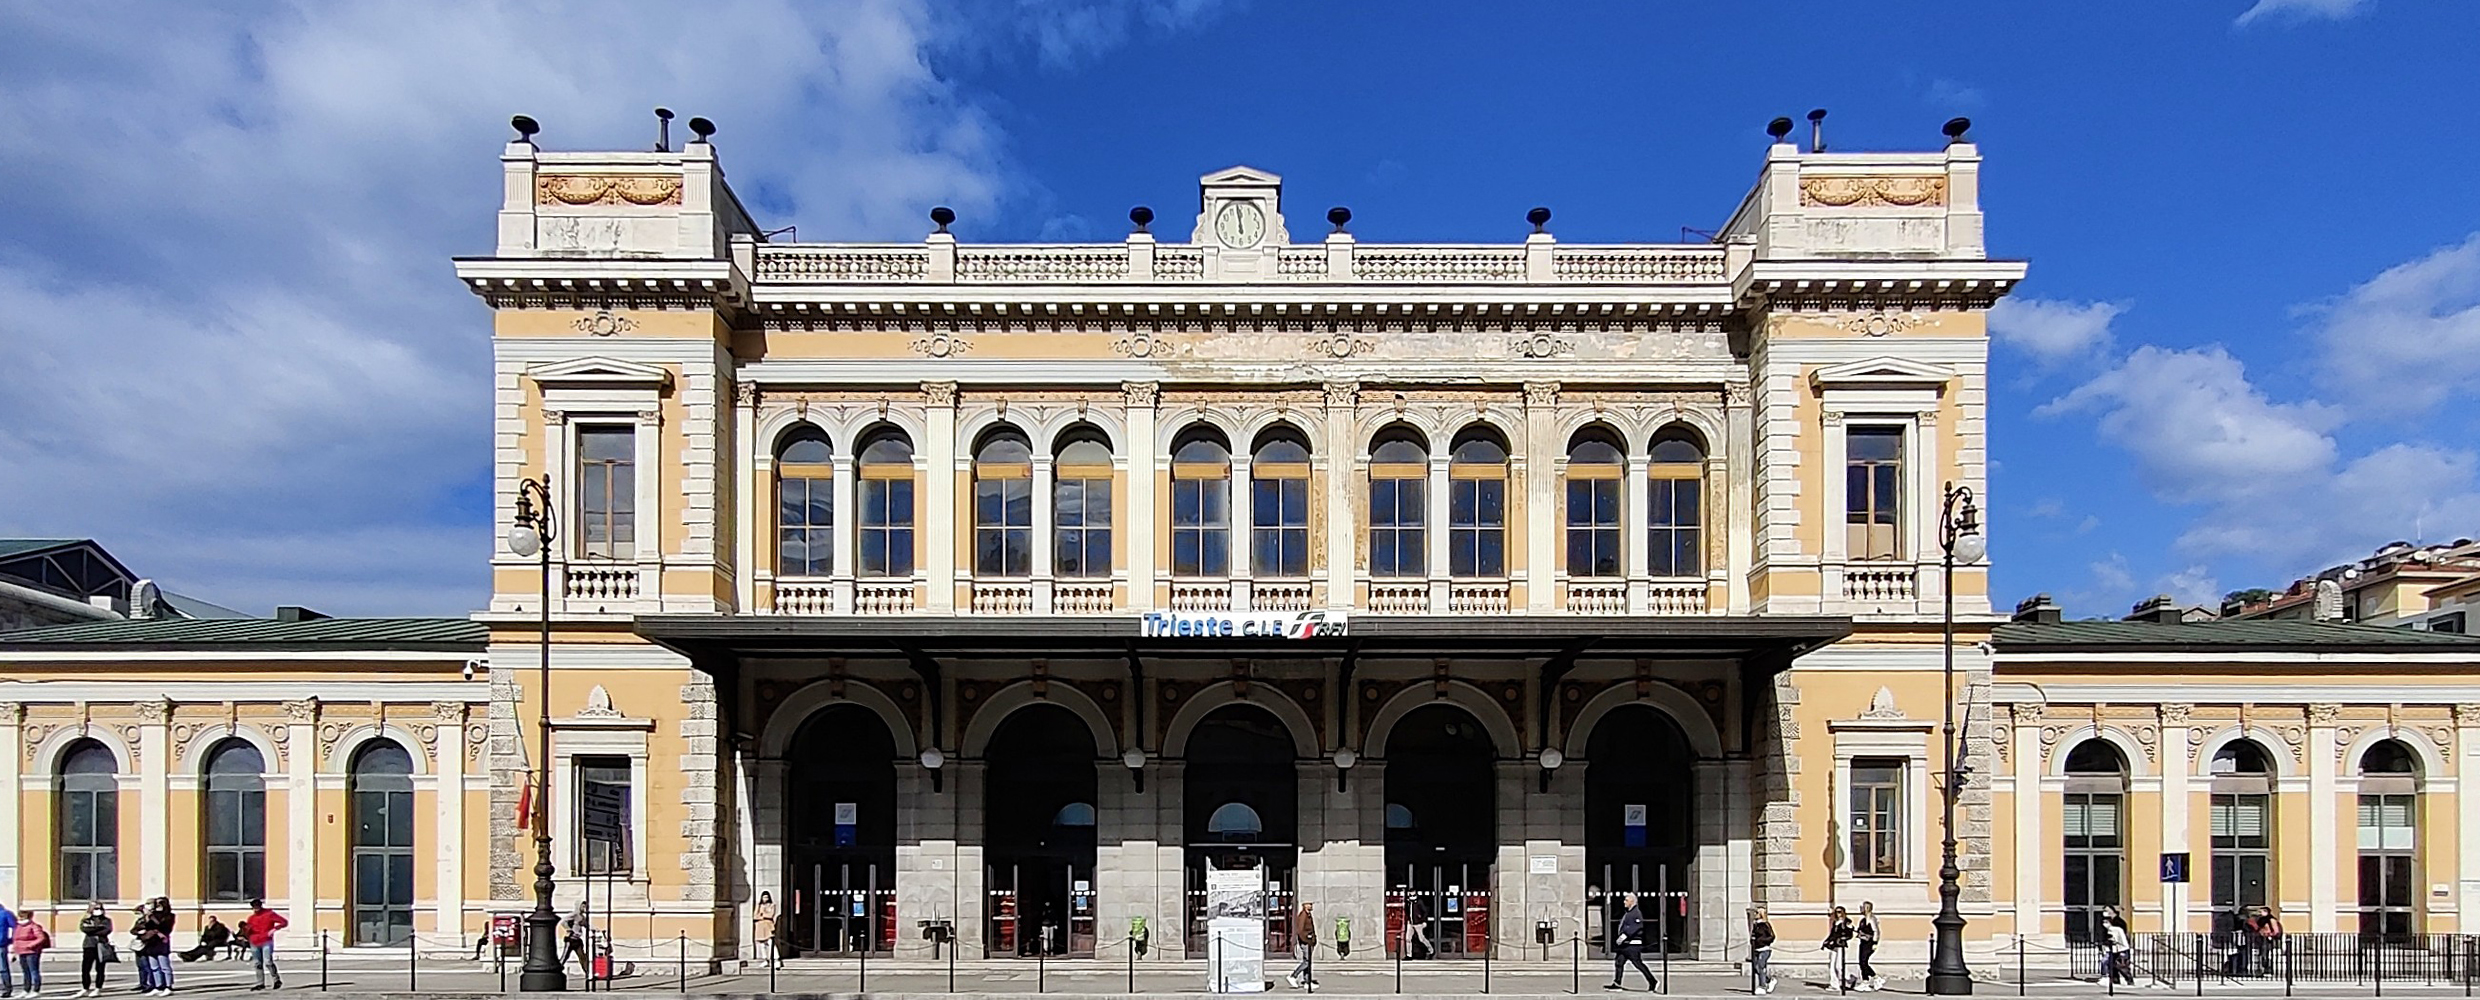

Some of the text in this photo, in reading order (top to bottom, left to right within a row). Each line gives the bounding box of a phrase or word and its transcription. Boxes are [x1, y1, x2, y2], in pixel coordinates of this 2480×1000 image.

[1229, 208, 1234, 216] 11
[1223, 213, 1229, 222] 10
[1220, 222, 1225, 231] 9
[1223, 231, 1228, 240] 8
[1230, 236, 1234, 244] 7
[1238, 238, 1243, 246] 6
[1248, 236, 1252, 244] 5
[1144, 613, 1233, 636] Trieste
